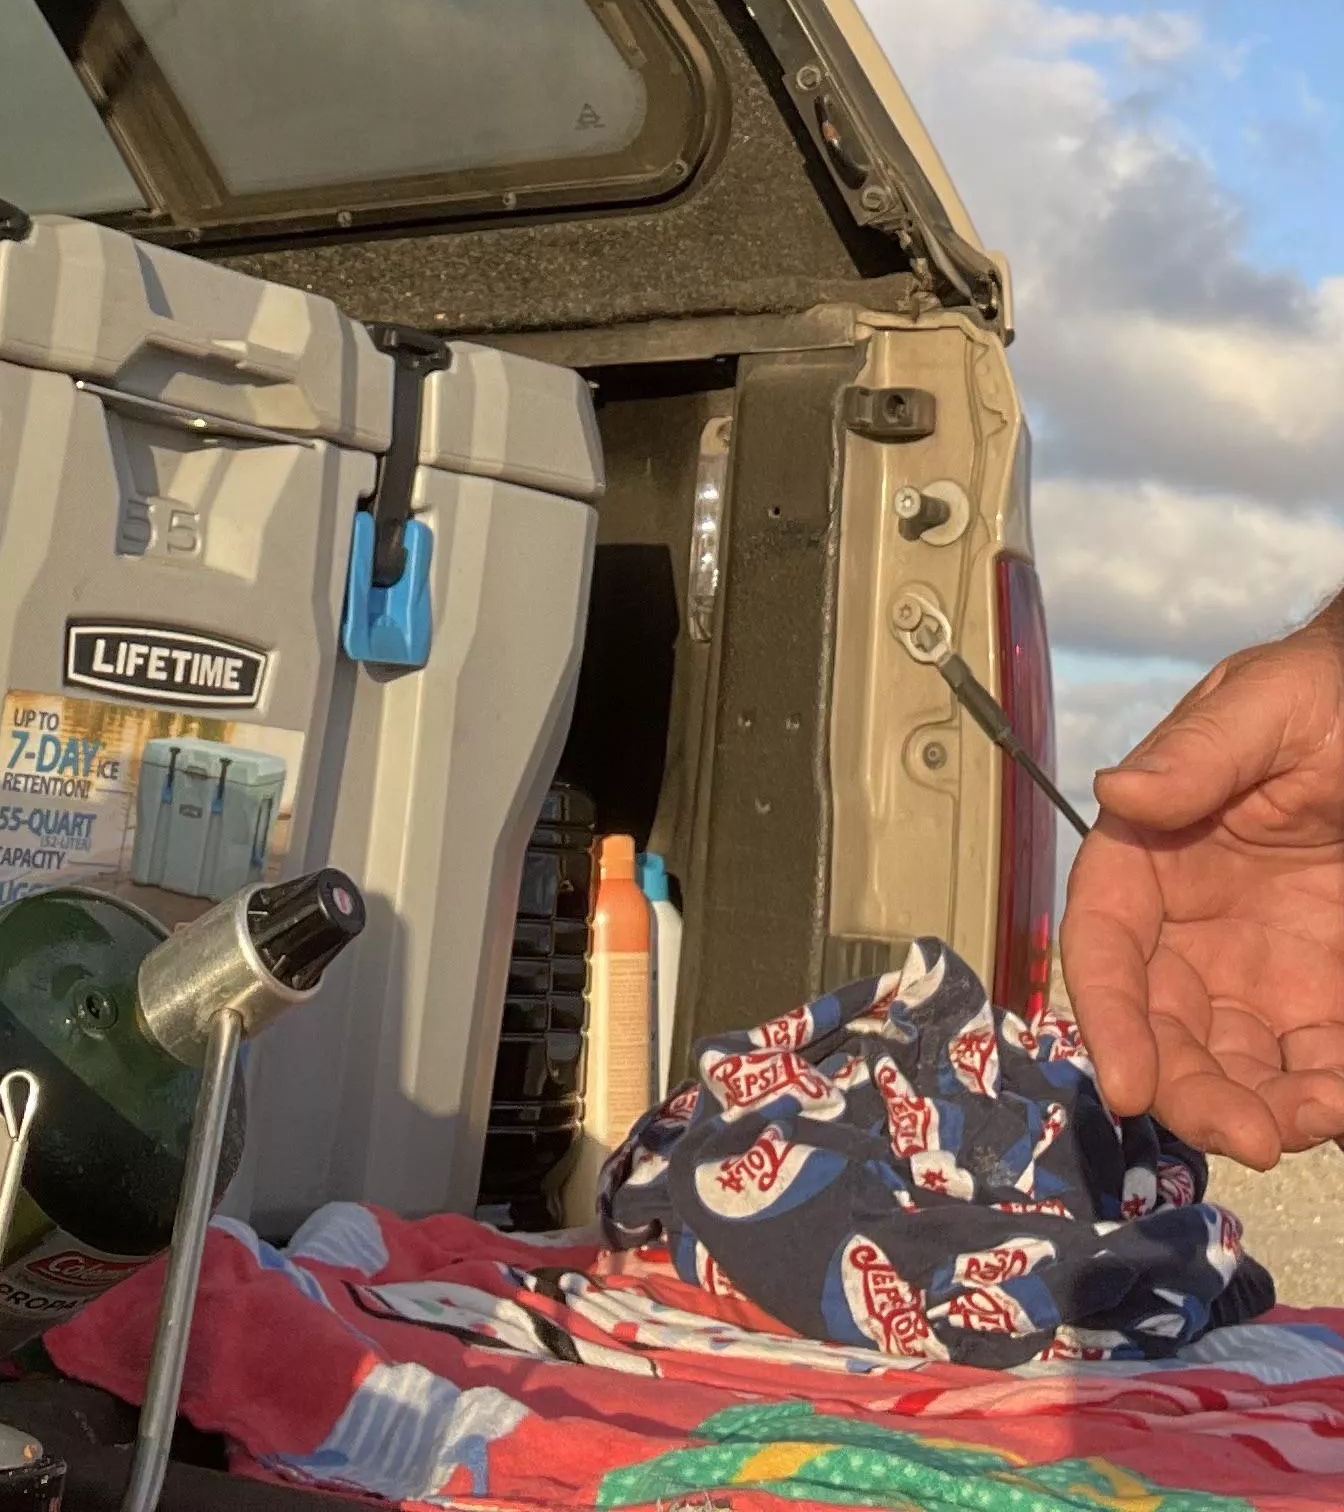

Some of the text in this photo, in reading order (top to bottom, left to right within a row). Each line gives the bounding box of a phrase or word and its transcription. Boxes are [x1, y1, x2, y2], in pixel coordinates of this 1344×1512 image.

[92, 638, 243, 691] LIFETIME
[14, 707, 60, 731] UP TO
[97, 759, 120, 781] ICE
[2, 772, 93, 799] RETENTION!
[709, 1051, 780, 1108] PEPSI
